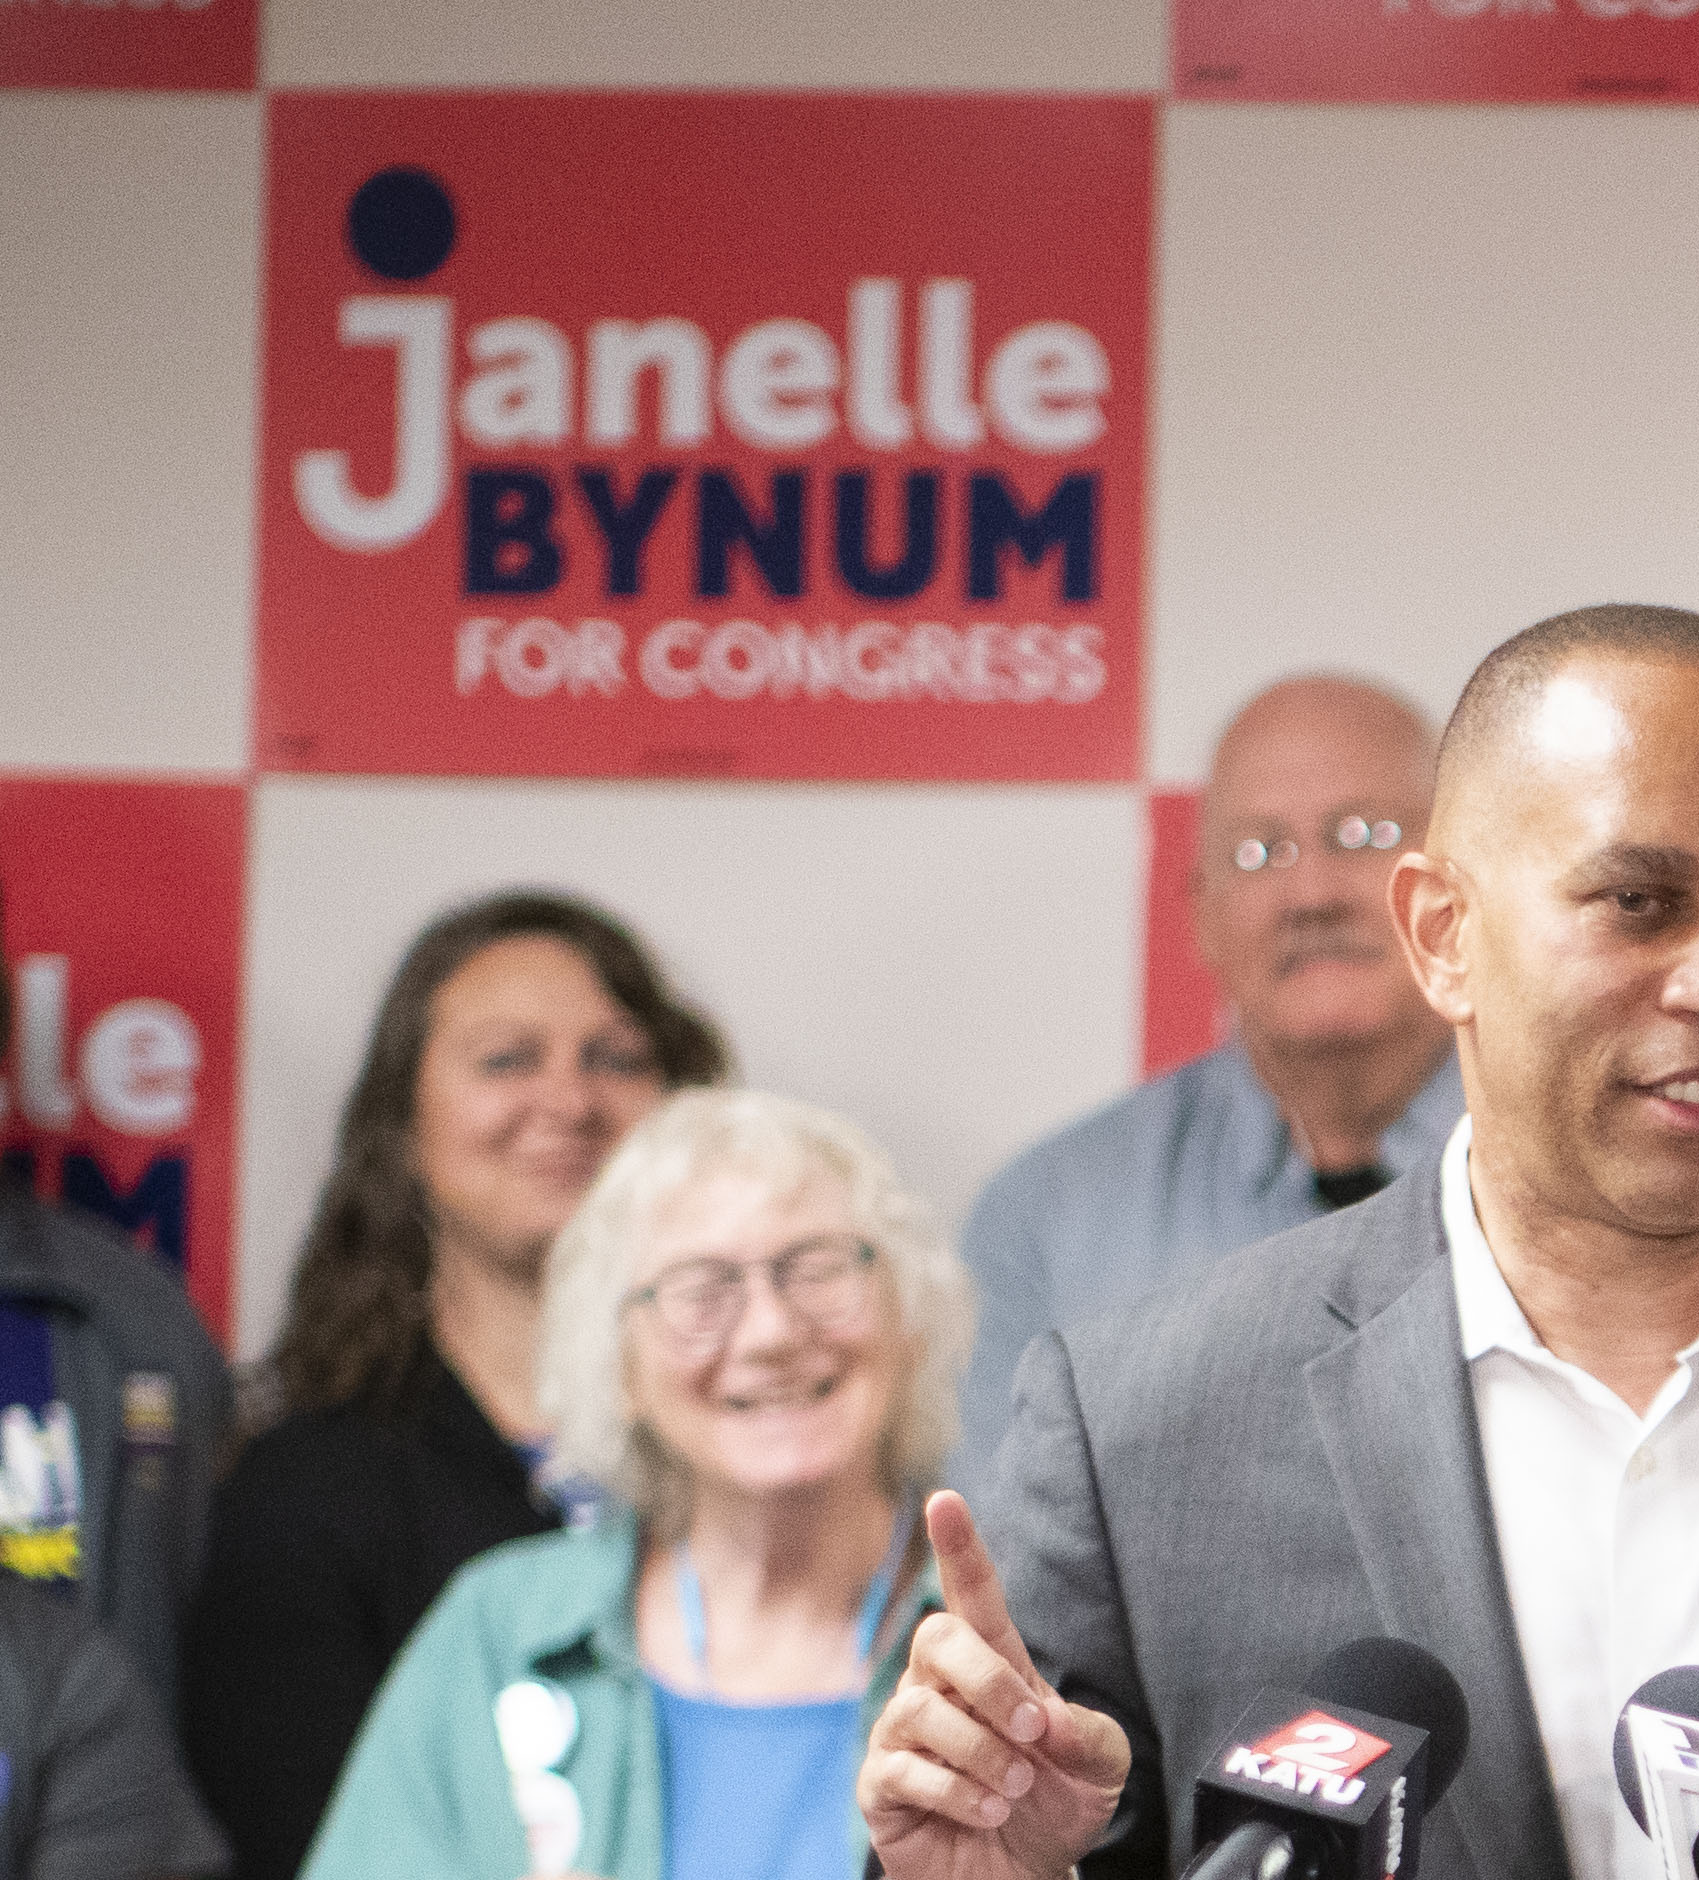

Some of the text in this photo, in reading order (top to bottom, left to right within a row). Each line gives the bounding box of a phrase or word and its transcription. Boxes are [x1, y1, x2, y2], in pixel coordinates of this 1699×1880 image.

[462, 465, 1101, 601] BYNUM
[456, 615, 1105, 704] FOR CONGRESS
[1224, 1747, 1366, 1805] KATU
[1272, 1723, 1357, 1771] 2
